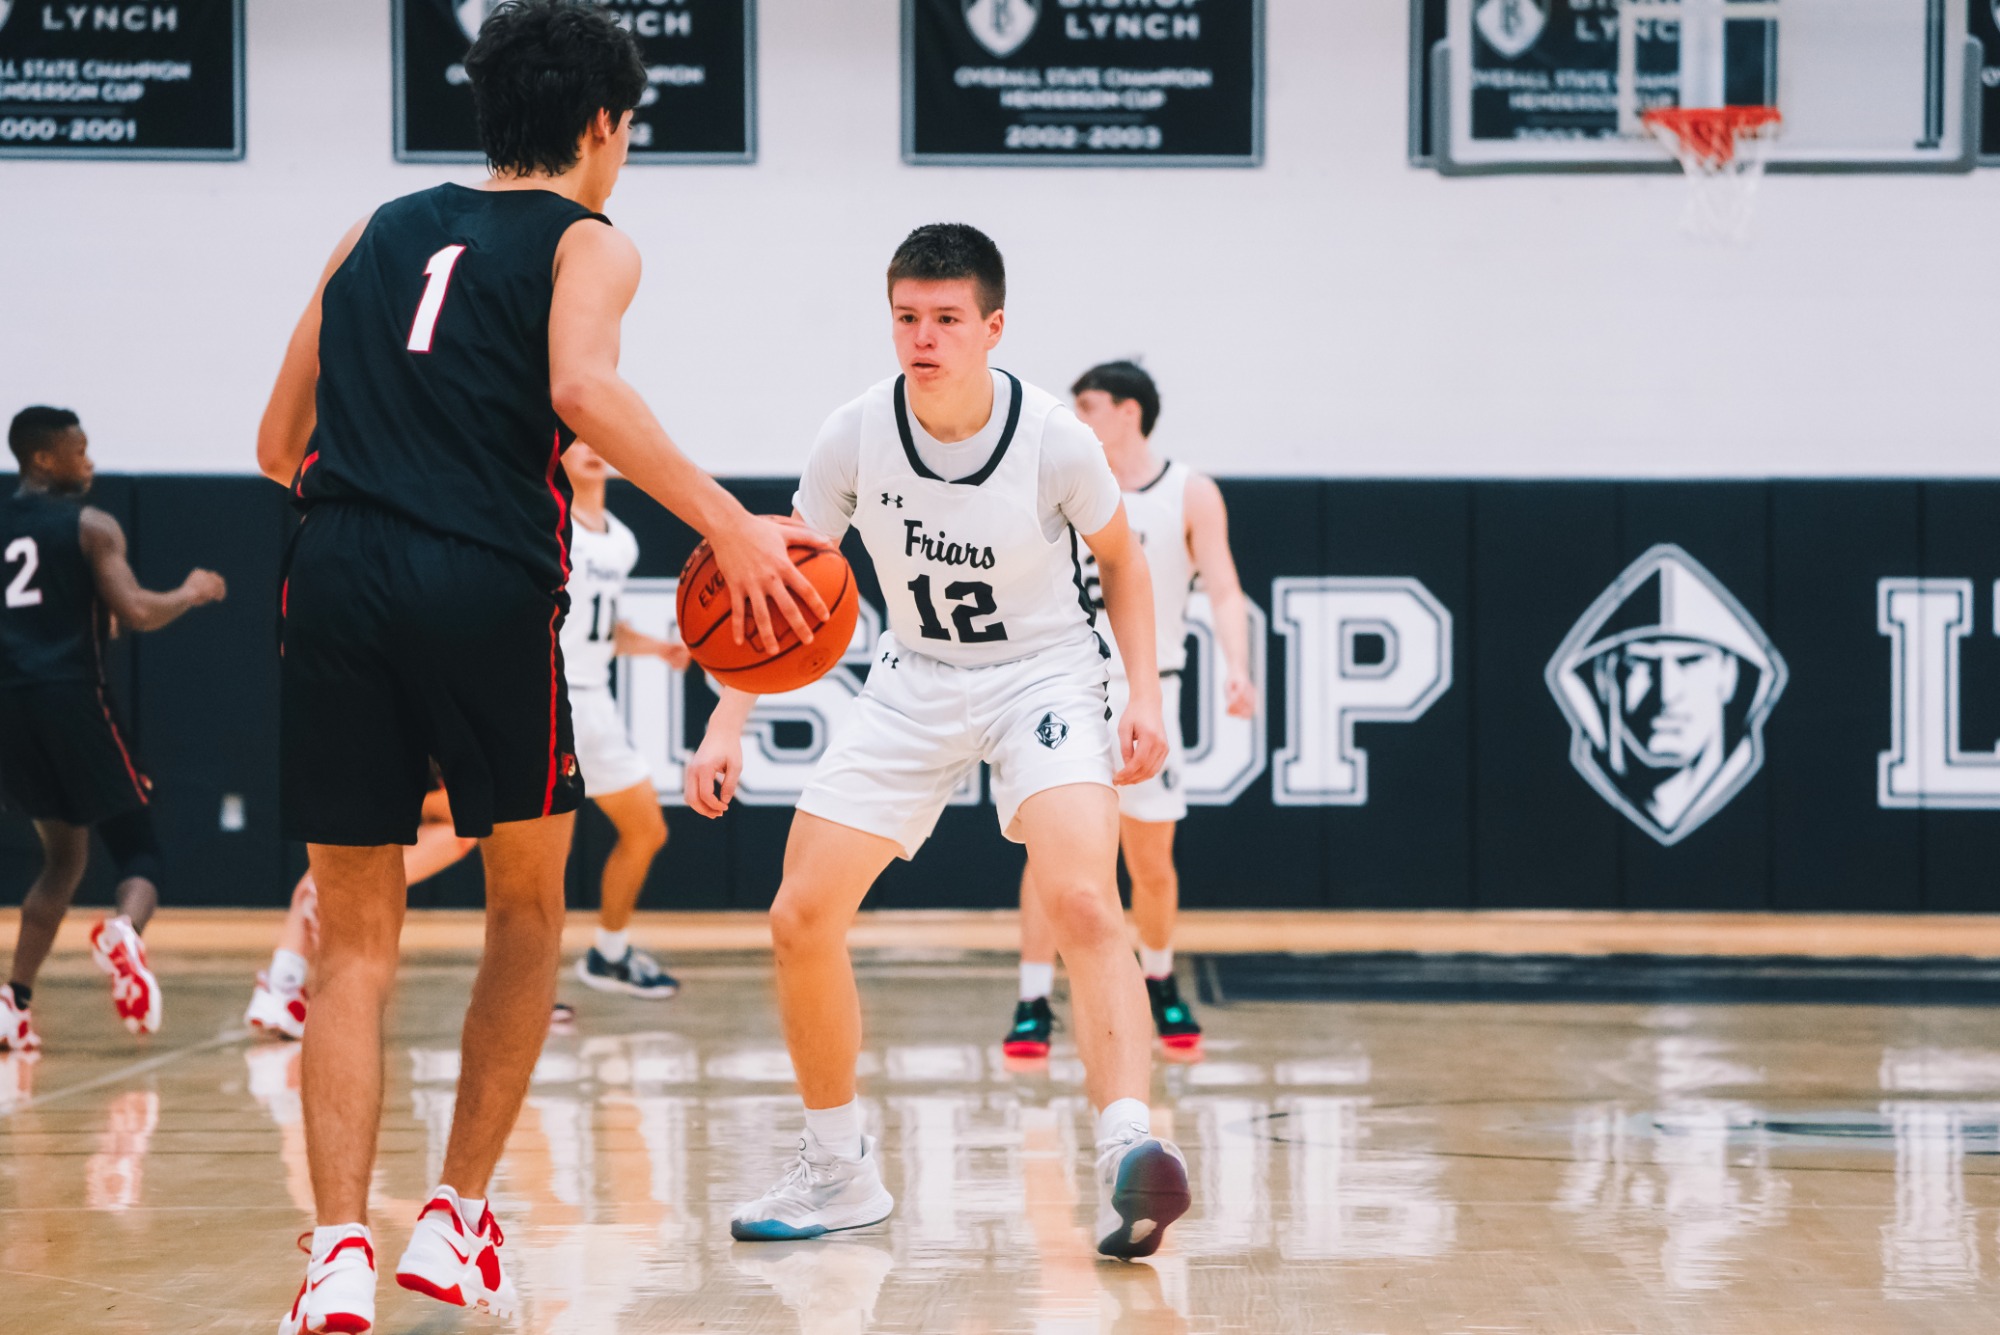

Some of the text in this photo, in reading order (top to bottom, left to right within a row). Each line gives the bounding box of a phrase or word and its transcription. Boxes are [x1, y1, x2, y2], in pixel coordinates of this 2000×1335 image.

[43, 5, 178, 31] LYNCH
[1065, 13, 1199, 40] LYNCH
[1575, 17, 1679, 42] LYNC
[23, 59, 79, 79] STATE
[82, 61, 191, 80] CHAMPION
[954, 67, 1213, 88] OVERALL STATE CHAMPION
[101, 82, 144, 101] CUP
[1005, 125, 1162, 149] 2002-2003
[406, 243, 467, 354] 1
[904, 519, 995, 569] Friars
[5, 536, 42, 608] 2
[907, 573, 1008, 643] 12
[1877, 577, 2000, 809] L
